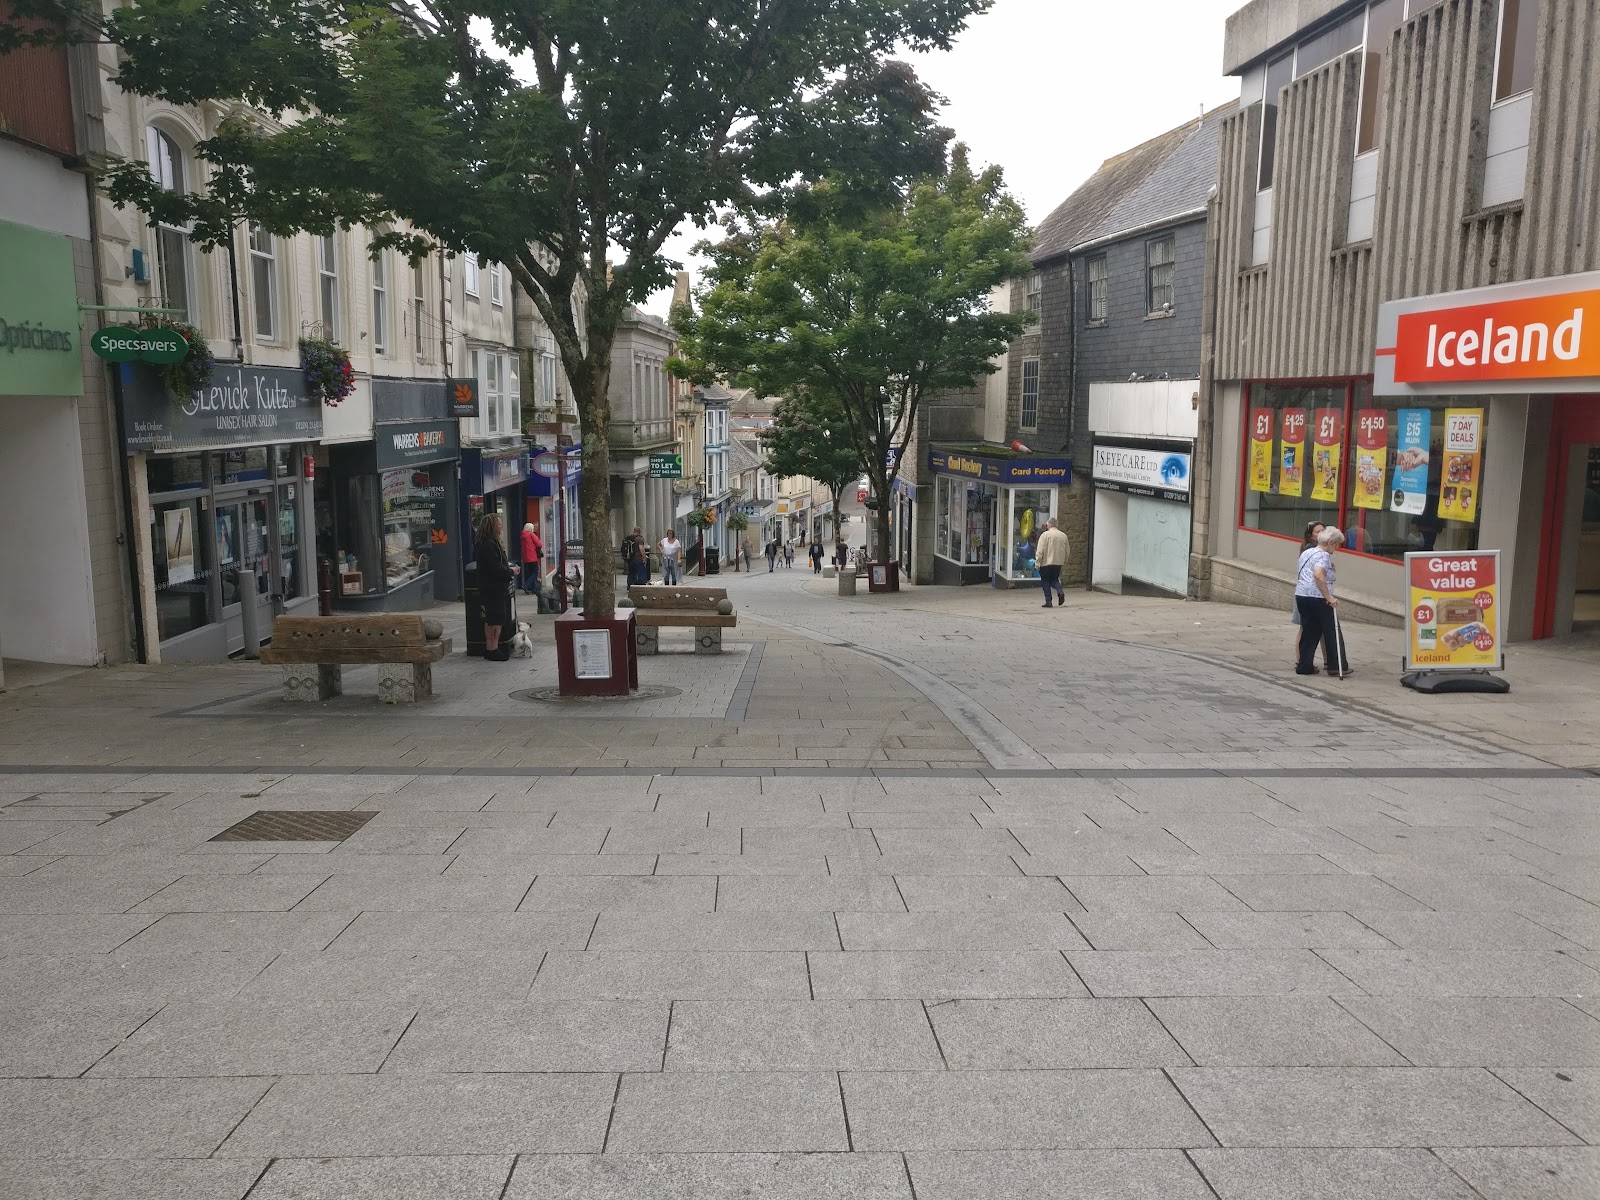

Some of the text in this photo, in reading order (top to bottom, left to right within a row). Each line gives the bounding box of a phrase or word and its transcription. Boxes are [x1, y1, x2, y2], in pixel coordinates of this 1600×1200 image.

[100, 336, 177, 352] Specsavers
[1425, 307, 1583, 368] Iceland
[201, 369, 250, 410] Levick
[254, 376, 288, 409] Kutz
[216, 414, 278, 429] UNISEX HAIR SALON
[1257, 415, 1268, 434] £1
[1285, 414, 1304, 433] £1.25
[1320, 416, 1334, 437] £1
[1361, 417, 1384, 438] £1.50
[1452, 421, 1472, 430] 7 DAY
[1406, 422, 1421, 436] £15
[392, 433, 419, 449] WARRENS
[423, 431, 441, 446] BAKERY
[1450, 433, 1474, 442] DEALS
[1011, 467, 1031, 476] Card
[1034, 467, 1066, 477] Factory
[1146, 462, 1158, 471] LTD
[1101, 468, 1151, 482] Independent Optical Centre
[1428, 558, 1477, 572] Great
[1430, 574, 1476, 588] value
[1417, 609, 1430, 619] £1
[1415, 654, 1451, 662] Iceland
